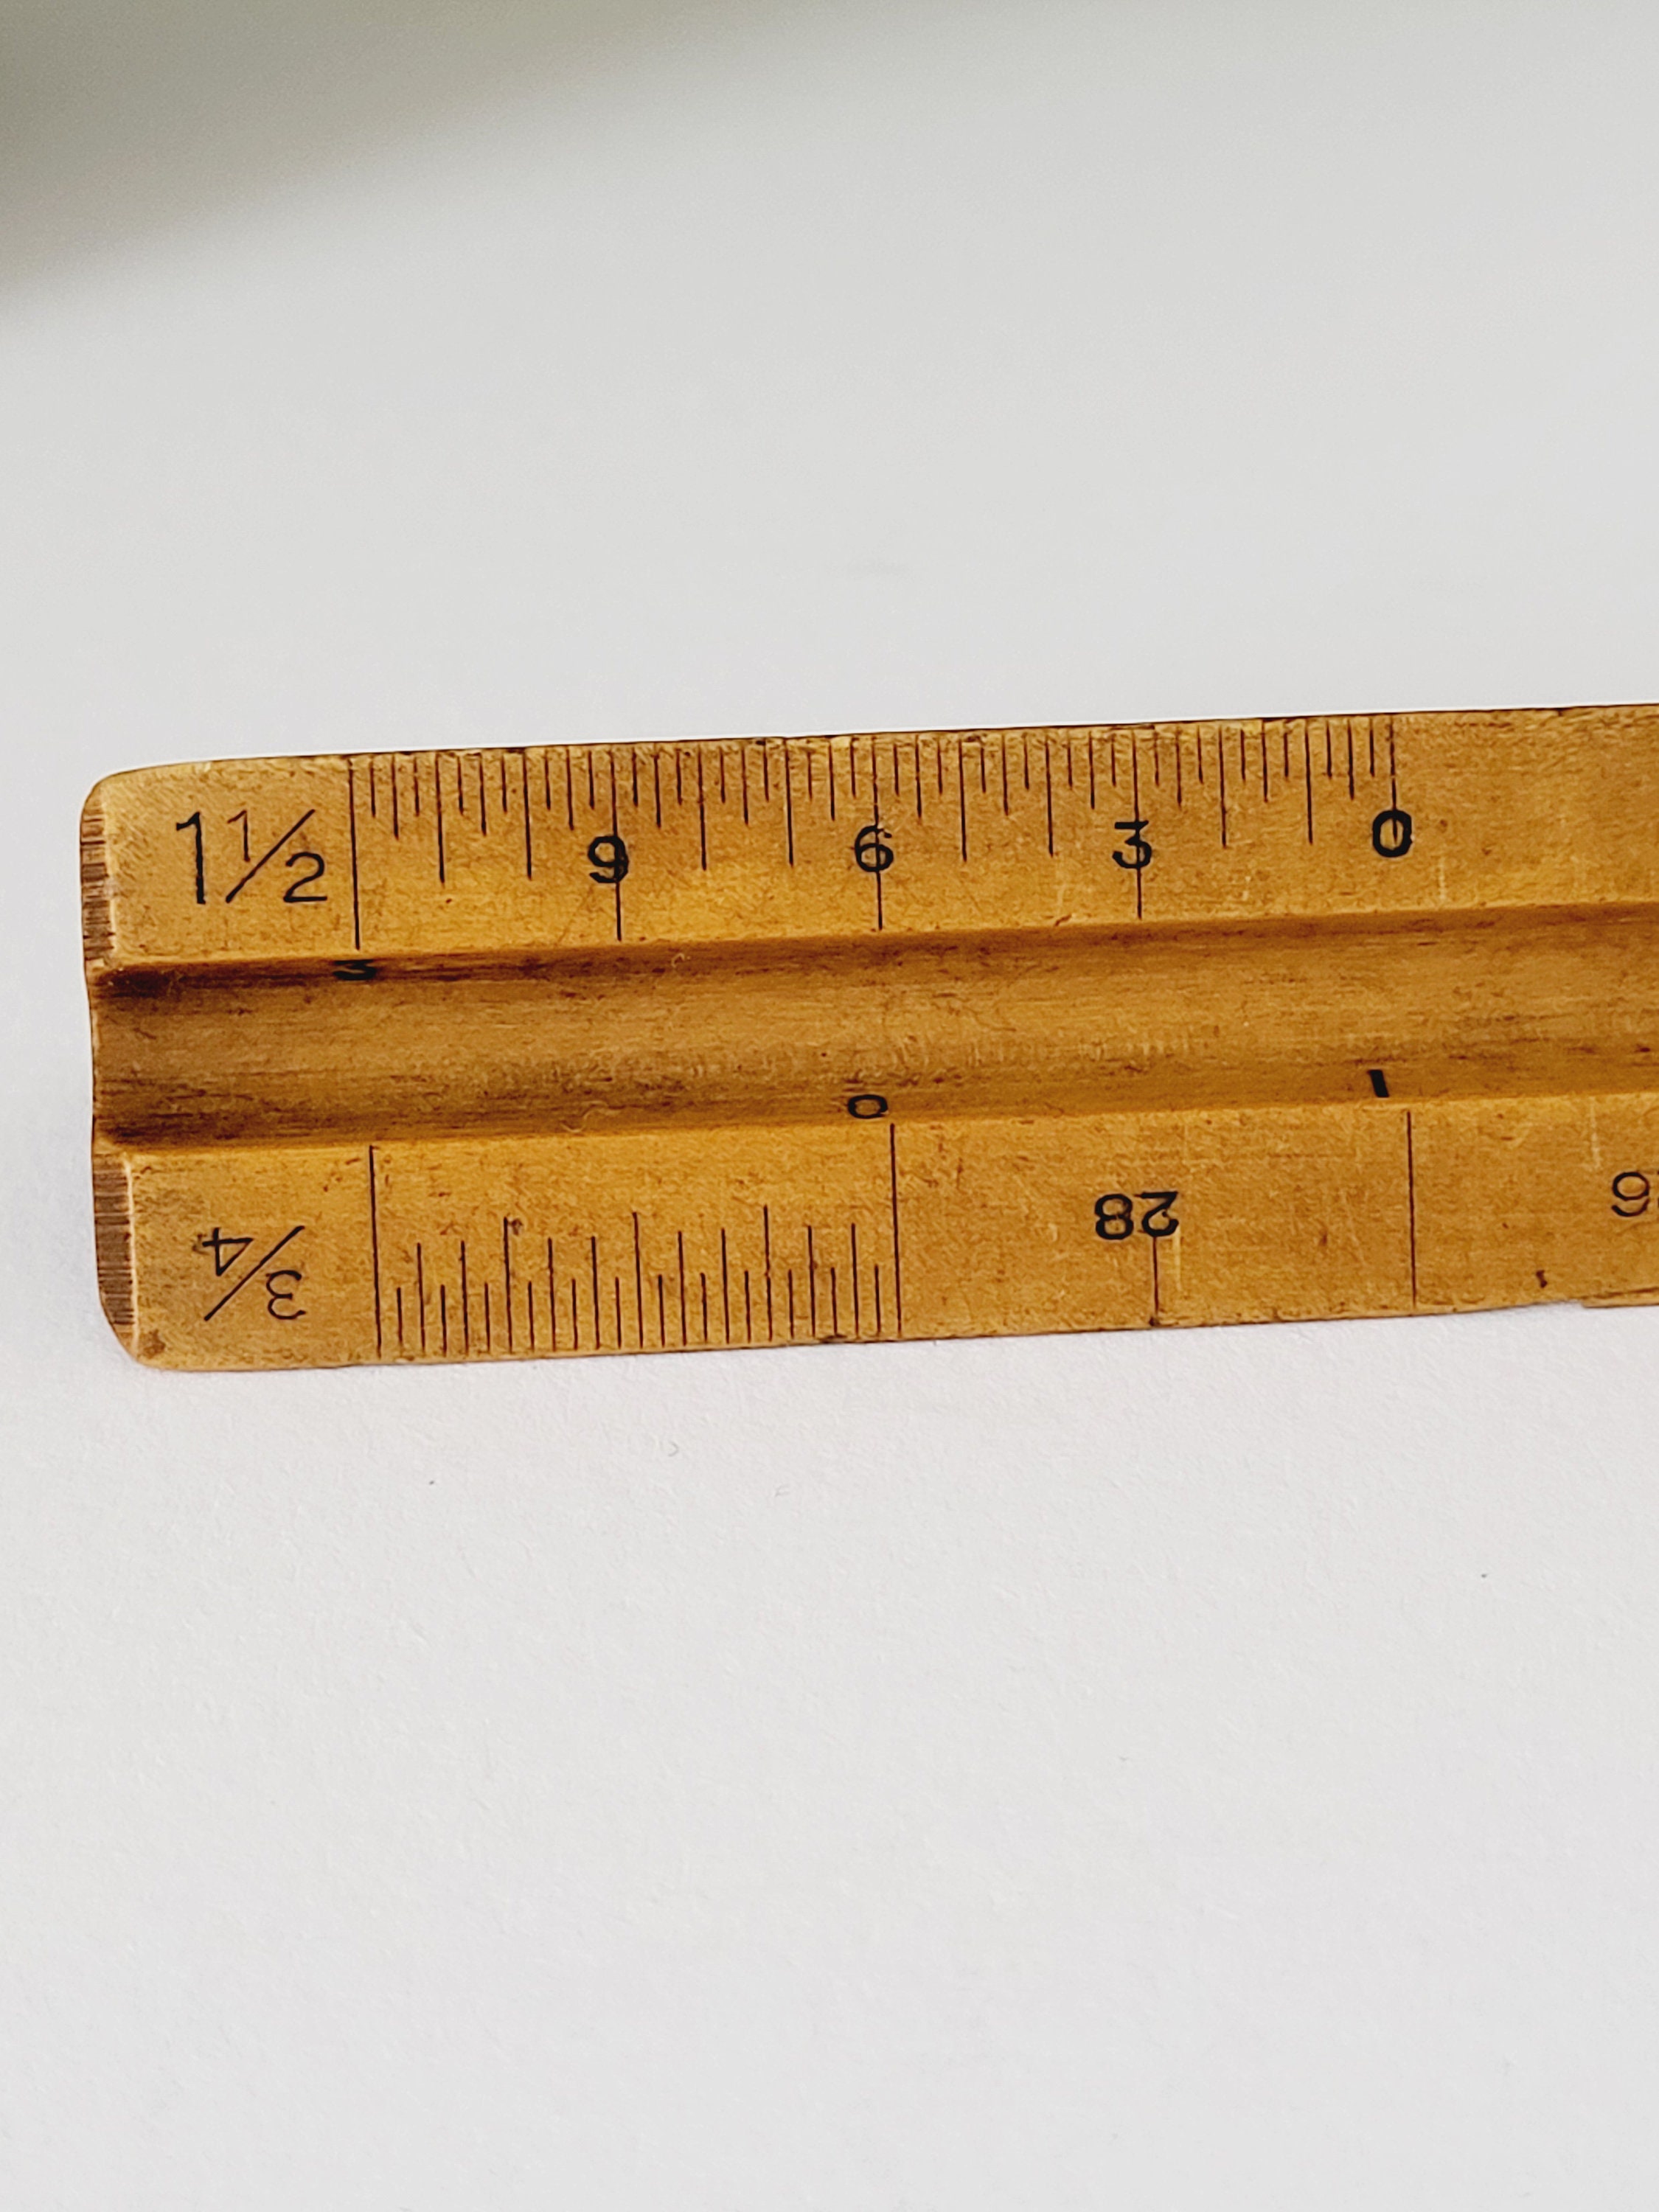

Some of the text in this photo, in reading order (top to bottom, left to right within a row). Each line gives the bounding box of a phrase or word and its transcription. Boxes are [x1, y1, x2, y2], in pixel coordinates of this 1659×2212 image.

[588, 809, 1413, 884] 9 6 3 0
[847, 1094, 888, 1119] 0
[1093, 1171, 1659, 1241] 28 6
[201, 1225, 307, 1322] 3/4
